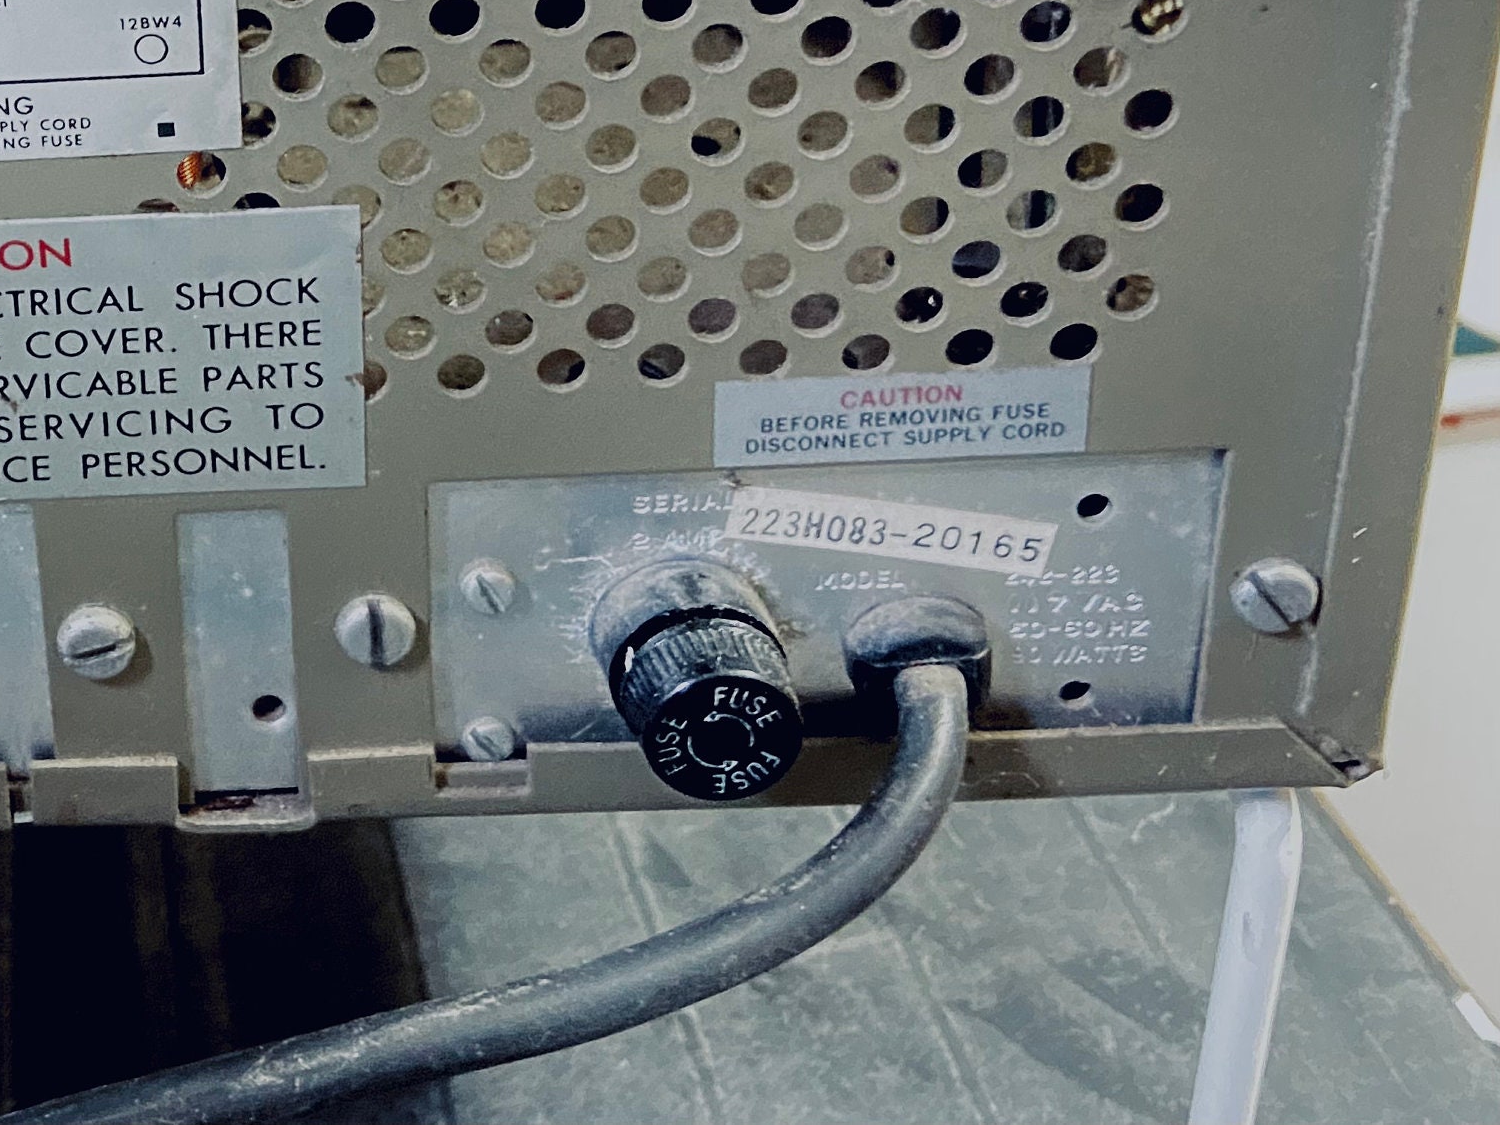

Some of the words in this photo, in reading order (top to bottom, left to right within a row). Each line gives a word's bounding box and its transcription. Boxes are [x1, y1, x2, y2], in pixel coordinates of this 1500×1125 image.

[120, 15, 182, 30] 12BW4
[40, 117, 91, 131] CORD
[41, 133, 83, 148] FUSE
[176, 277, 320, 312] SHOCK
[26, 326, 176, 358] COVER.
[203, 319, 322, 350] THERE
[203, 361, 325, 392] PARTS
[841, 385, 962, 410] CAUTION
[267, 403, 324, 431] TO
[761, 414, 847, 433] BEFORE
[859, 407, 980, 427] REMOVING
[993, 403, 1049, 420] FUSE
[746, 432, 892, 454] DISCONNECT
[905, 427, 989, 445] SUPPLY
[1003, 422, 1065, 440] CORD
[81, 445, 326, 479] PERSONNEL.
[633, 491, 734, 514] SERIAL
[739, 507, 1043, 564] 223H083-20165
[815, 571, 904, 591] MODEL
[714, 687, 782, 728] FUSE
[656, 717, 687, 775] FUSE
[712, 751, 780, 794] FUSE
